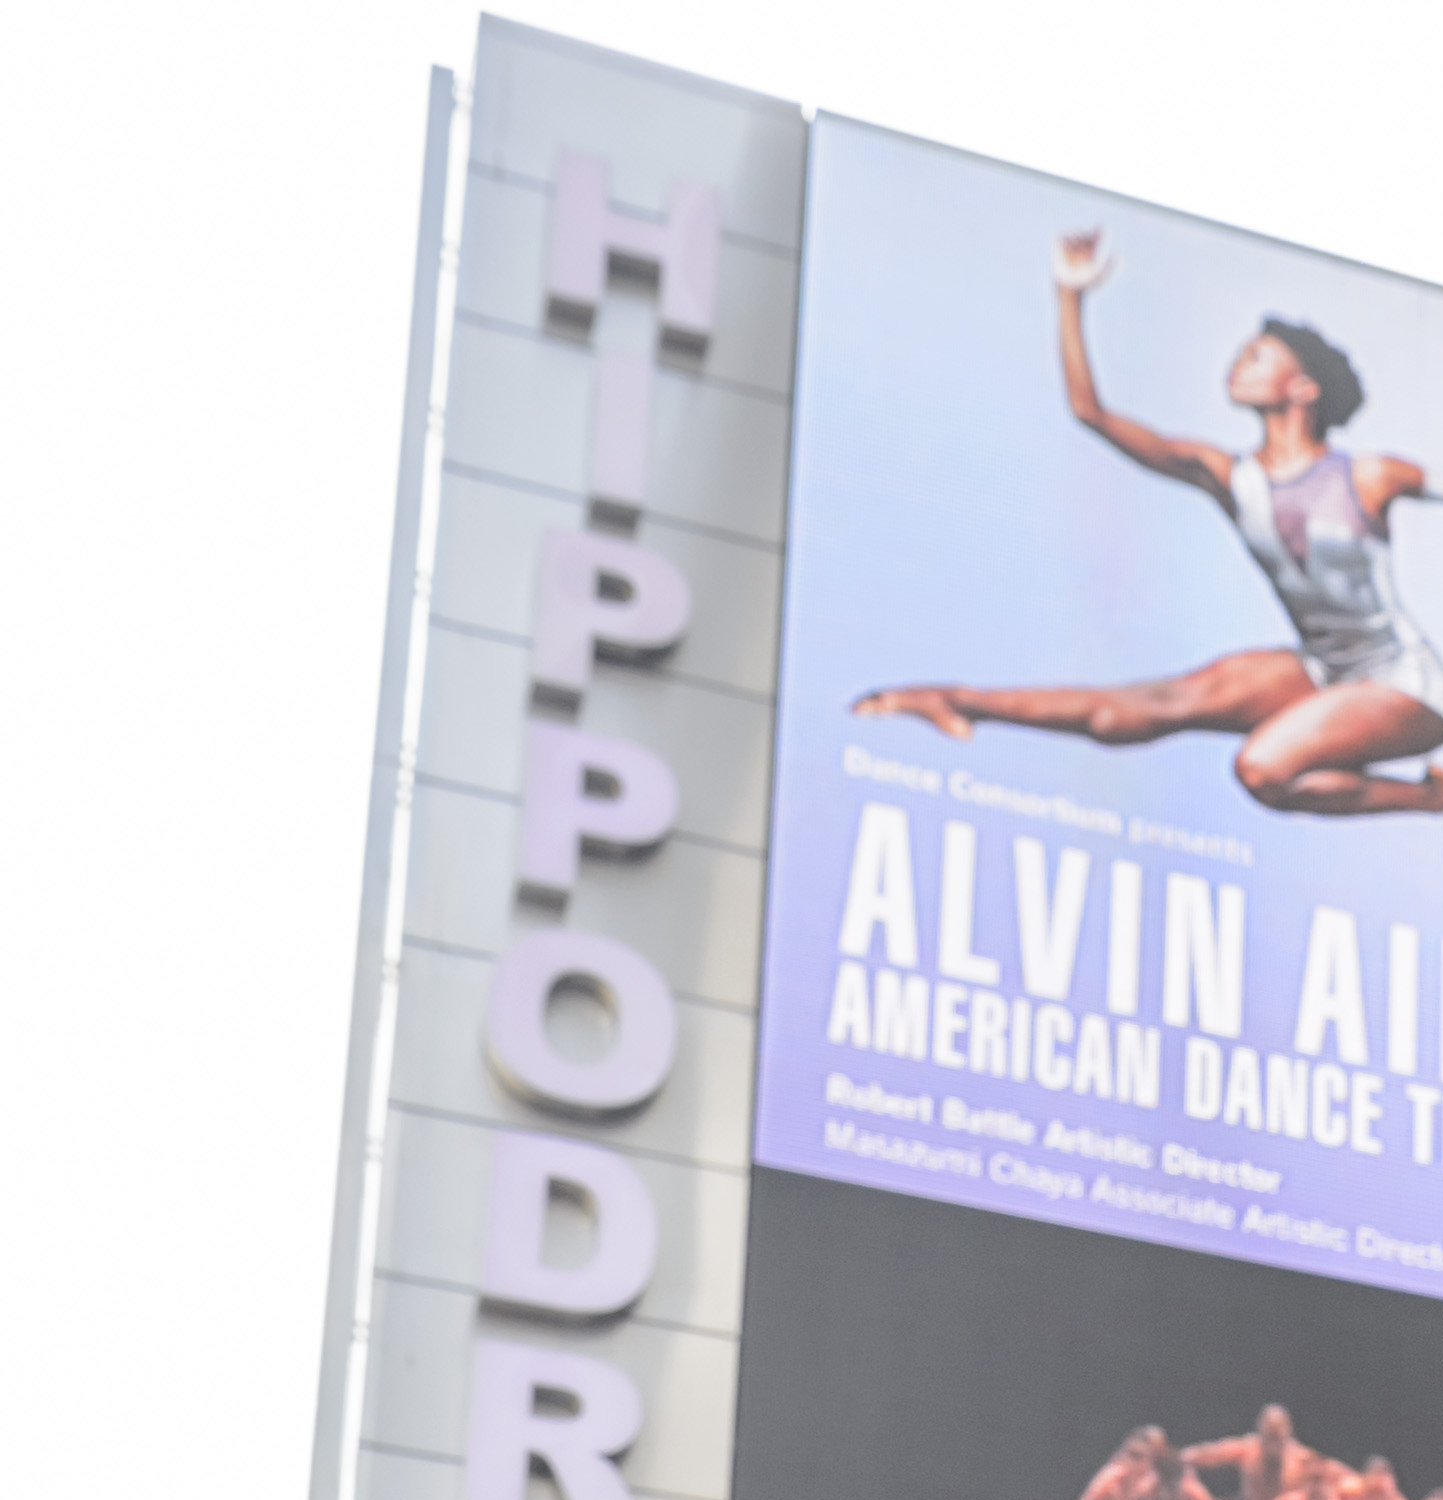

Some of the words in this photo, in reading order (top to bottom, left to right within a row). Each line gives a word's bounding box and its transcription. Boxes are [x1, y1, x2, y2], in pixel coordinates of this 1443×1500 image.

[843, 744, 942, 795] Dance
[947, 769, 1122, 836] Consortium
[839, 801, 1245, 1039] ALVIN
[826, 961, 1161, 1110] AMERICAN
[1186, 1037, 1384, 1156] DANCE
[825, 1072, 934, 1125] Robert
[942, 1097, 1035, 1146] Battle
[1043, 1120, 1154, 1170] Artistic
[1162, 1142, 1283, 1194] Director
[1090, 1175, 1236, 1231] Associate
[1241, 1205, 1349, 1253] Artistic
